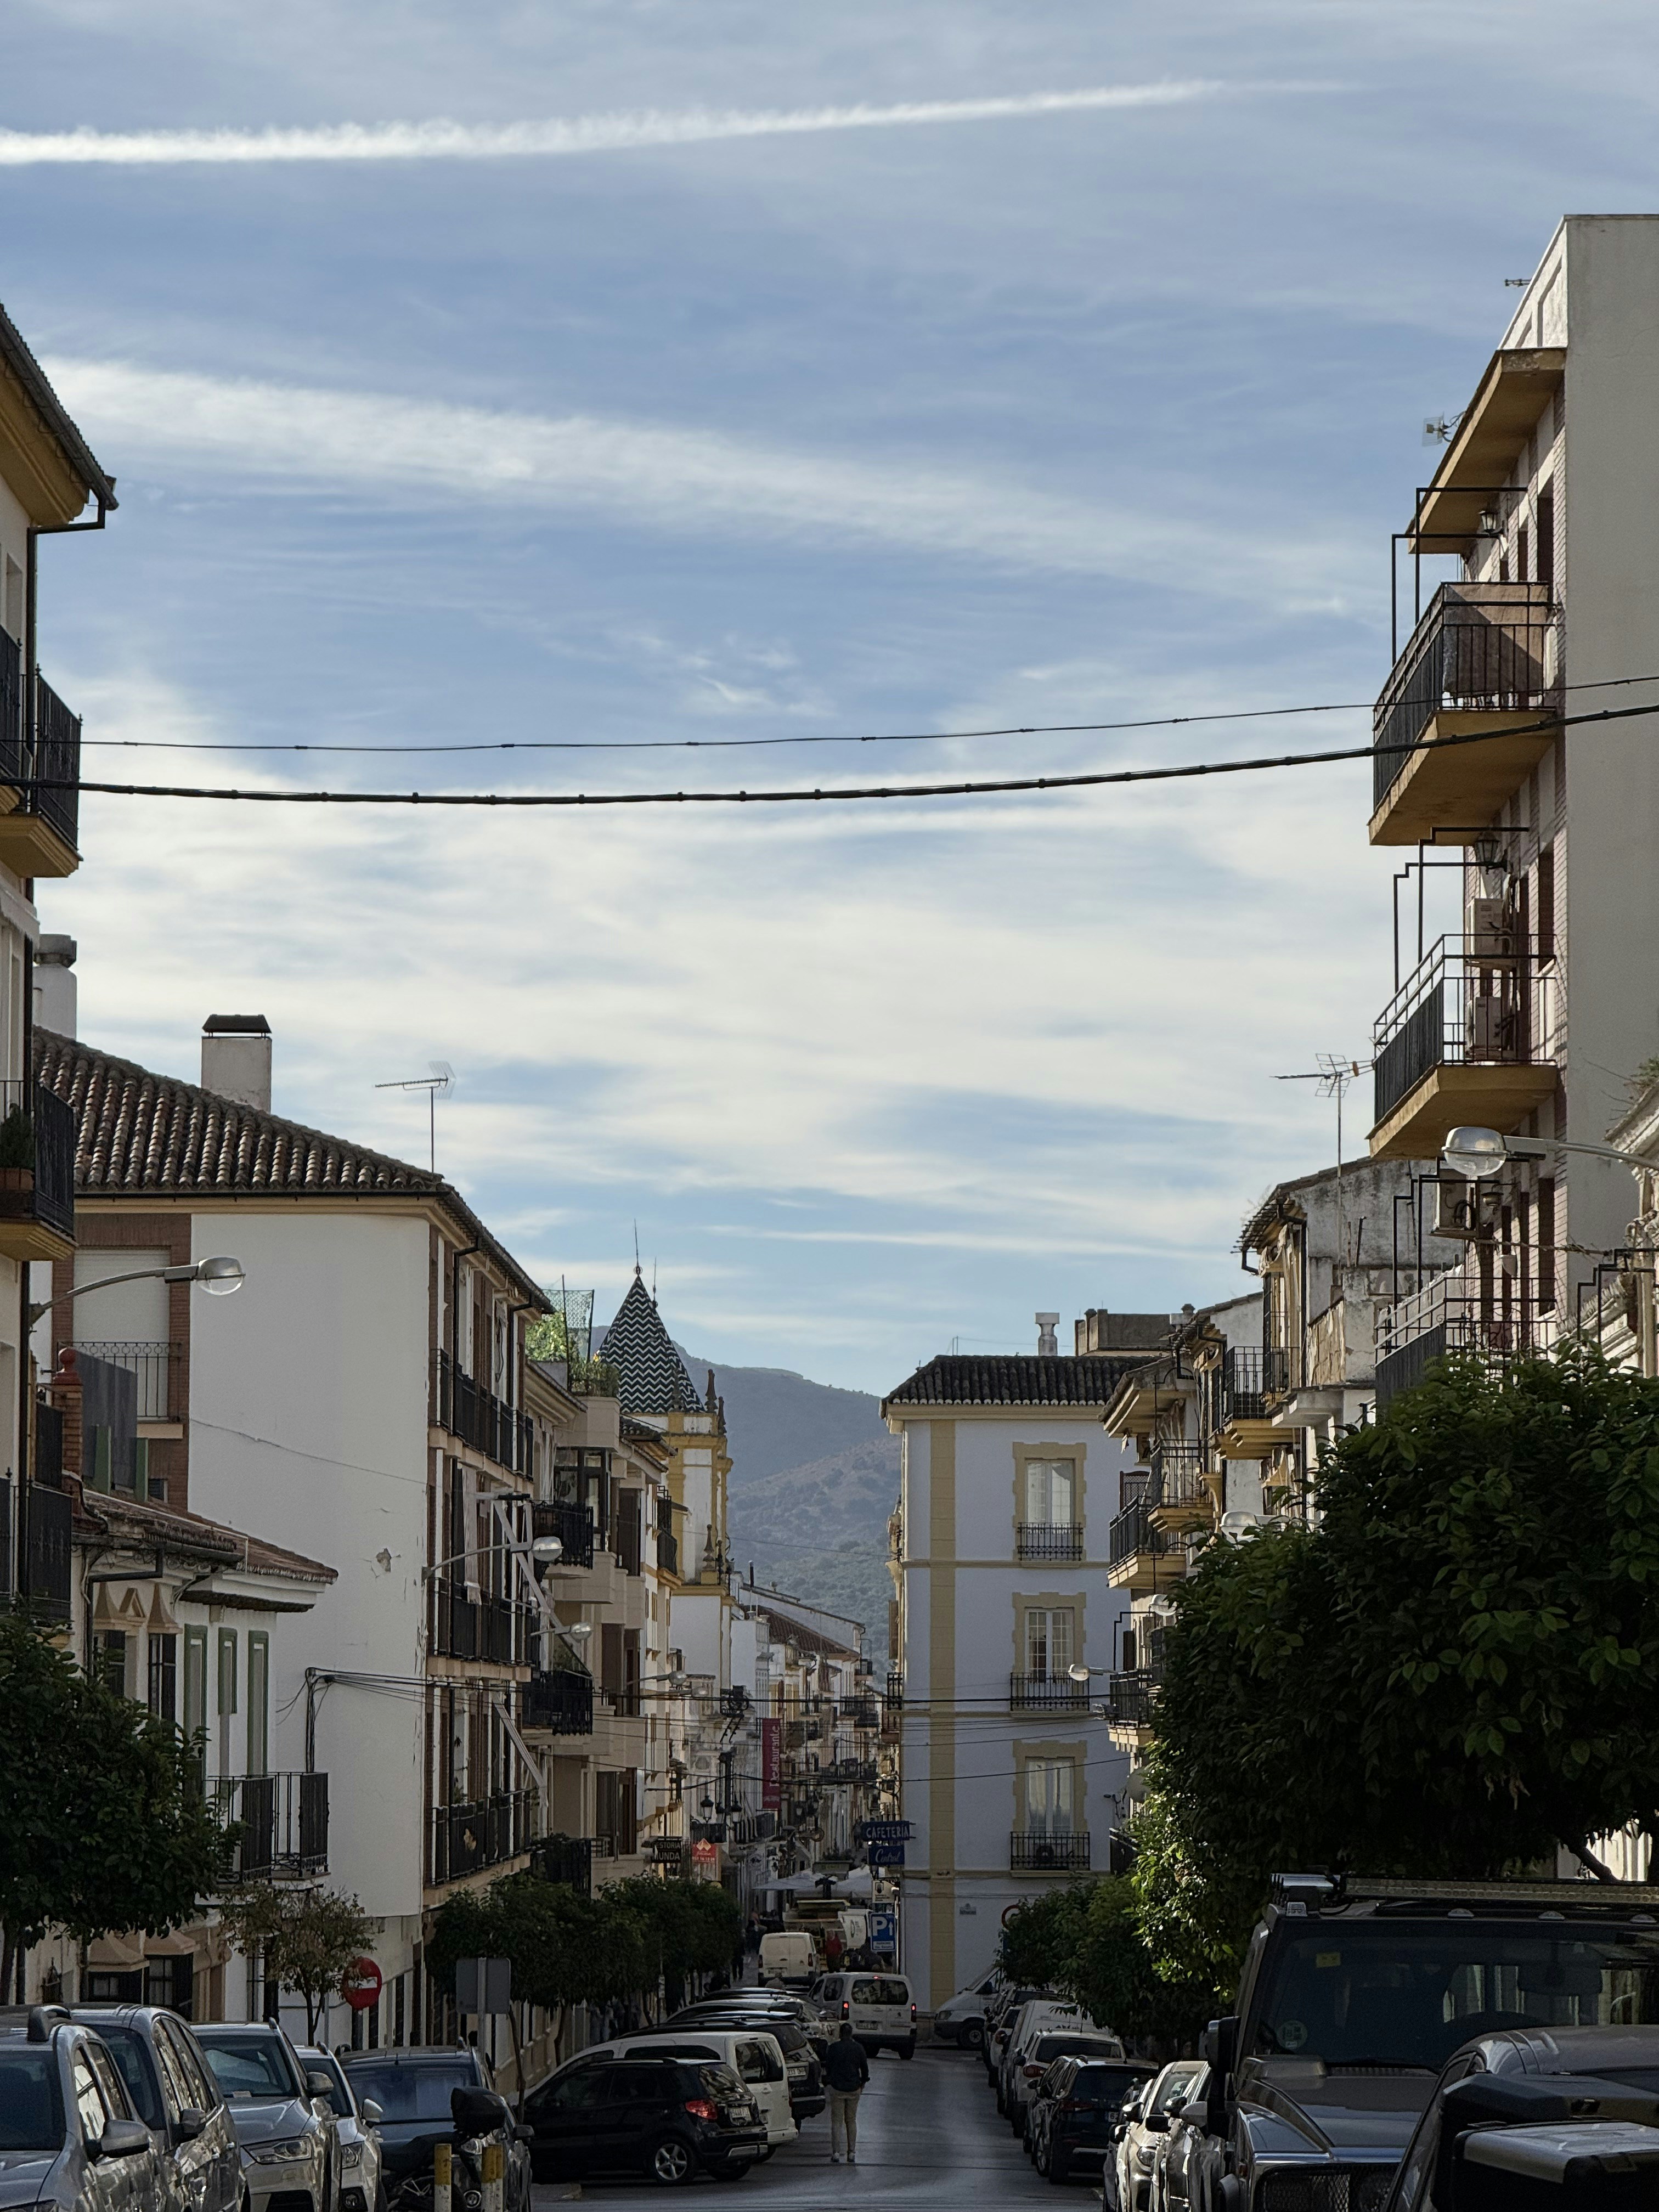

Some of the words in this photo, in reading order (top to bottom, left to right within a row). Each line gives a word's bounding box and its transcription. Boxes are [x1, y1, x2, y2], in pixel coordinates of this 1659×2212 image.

[769, 1725, 780, 1787] Restaurante
[875, 1848, 901, 1863] Central
[872, 1916, 888, 1936] P
